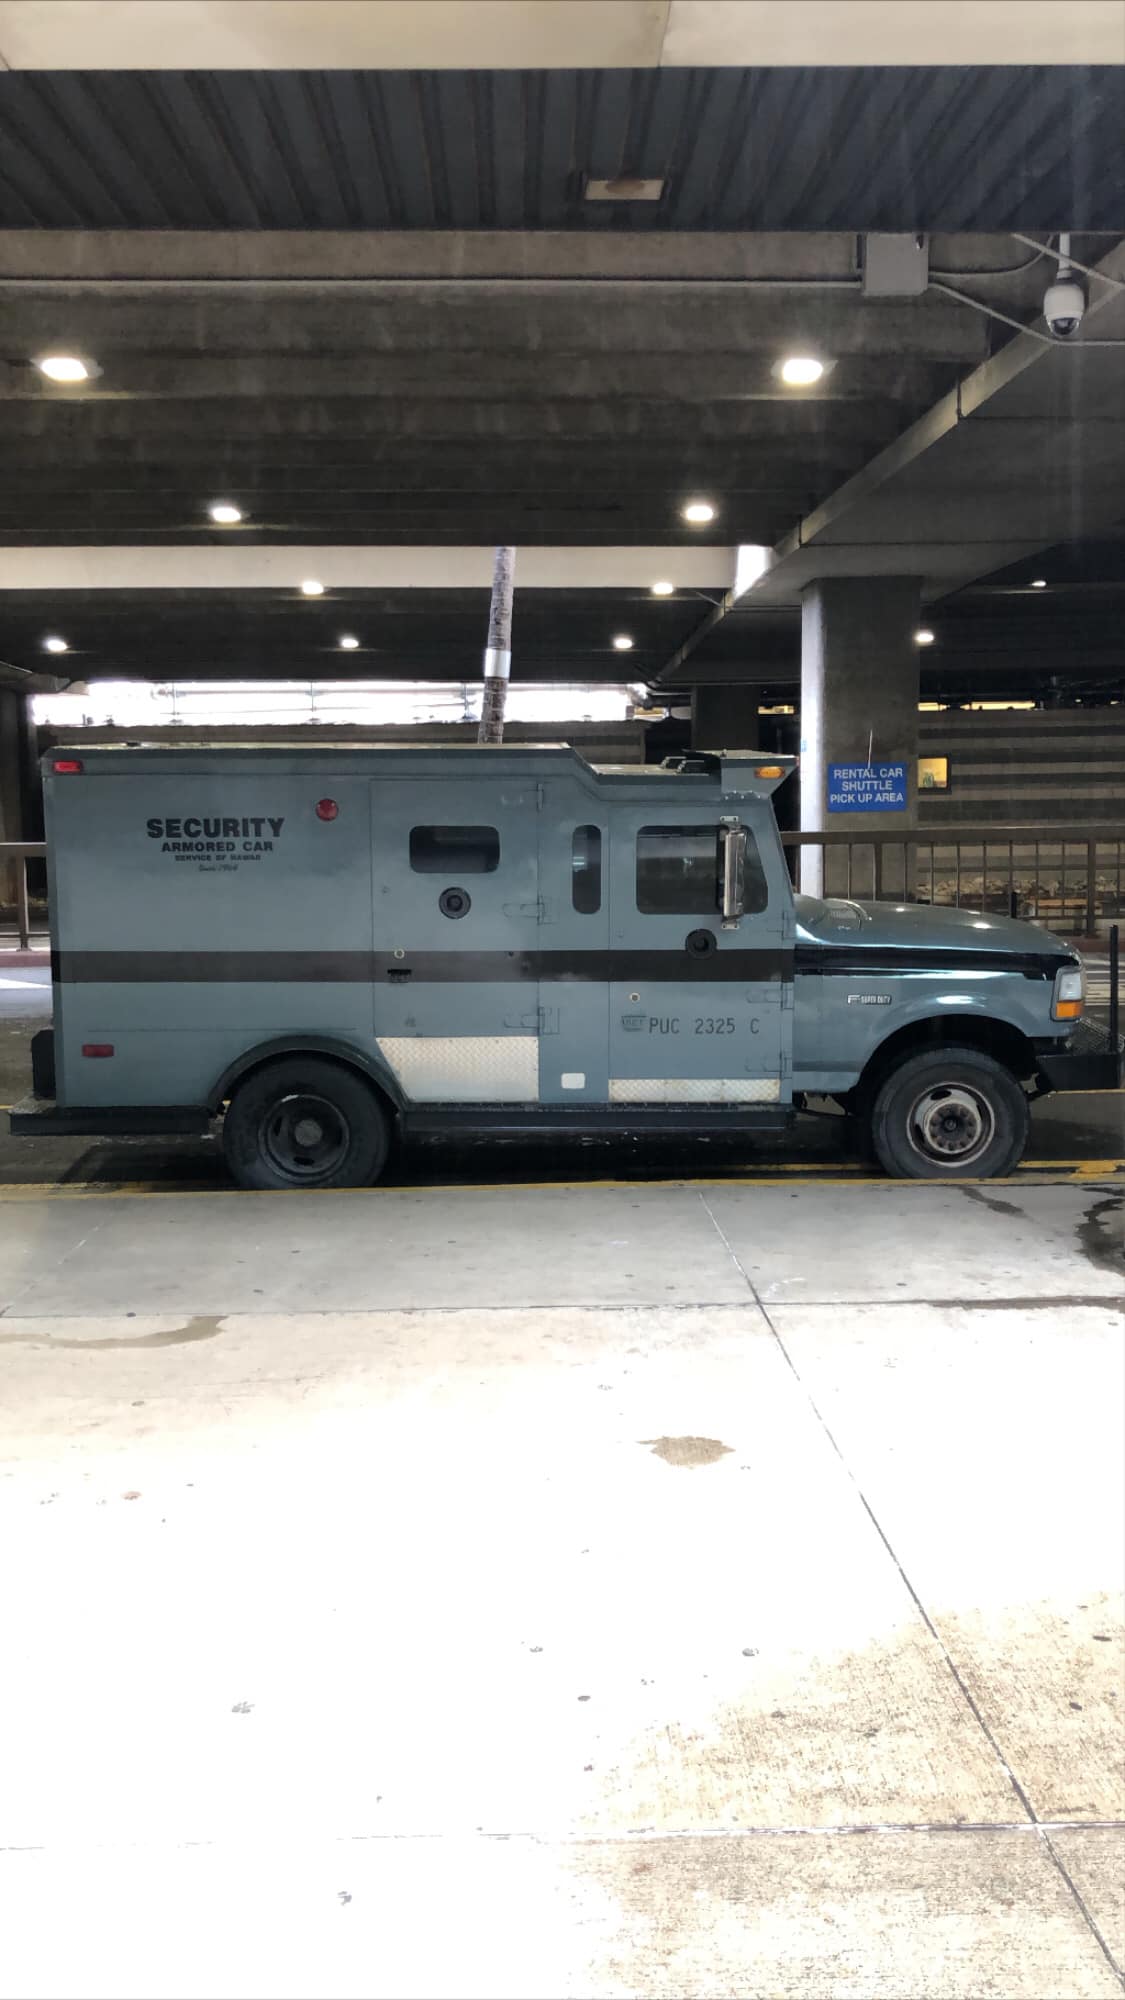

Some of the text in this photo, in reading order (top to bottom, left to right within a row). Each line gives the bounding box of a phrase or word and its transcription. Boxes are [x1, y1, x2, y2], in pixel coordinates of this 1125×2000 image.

[833, 767, 903, 779] RENTAL CAR
[841, 780, 893, 791] SHUTTLE
[830, 792, 904, 803] PICK UP AREA
[146, 817, 285, 839] SECURITY
[161, 841, 274, 852] ARMORED CAR
[175, 854, 212, 862] SERVICE
[649, 1017, 760, 1035] PUC 2325 C
